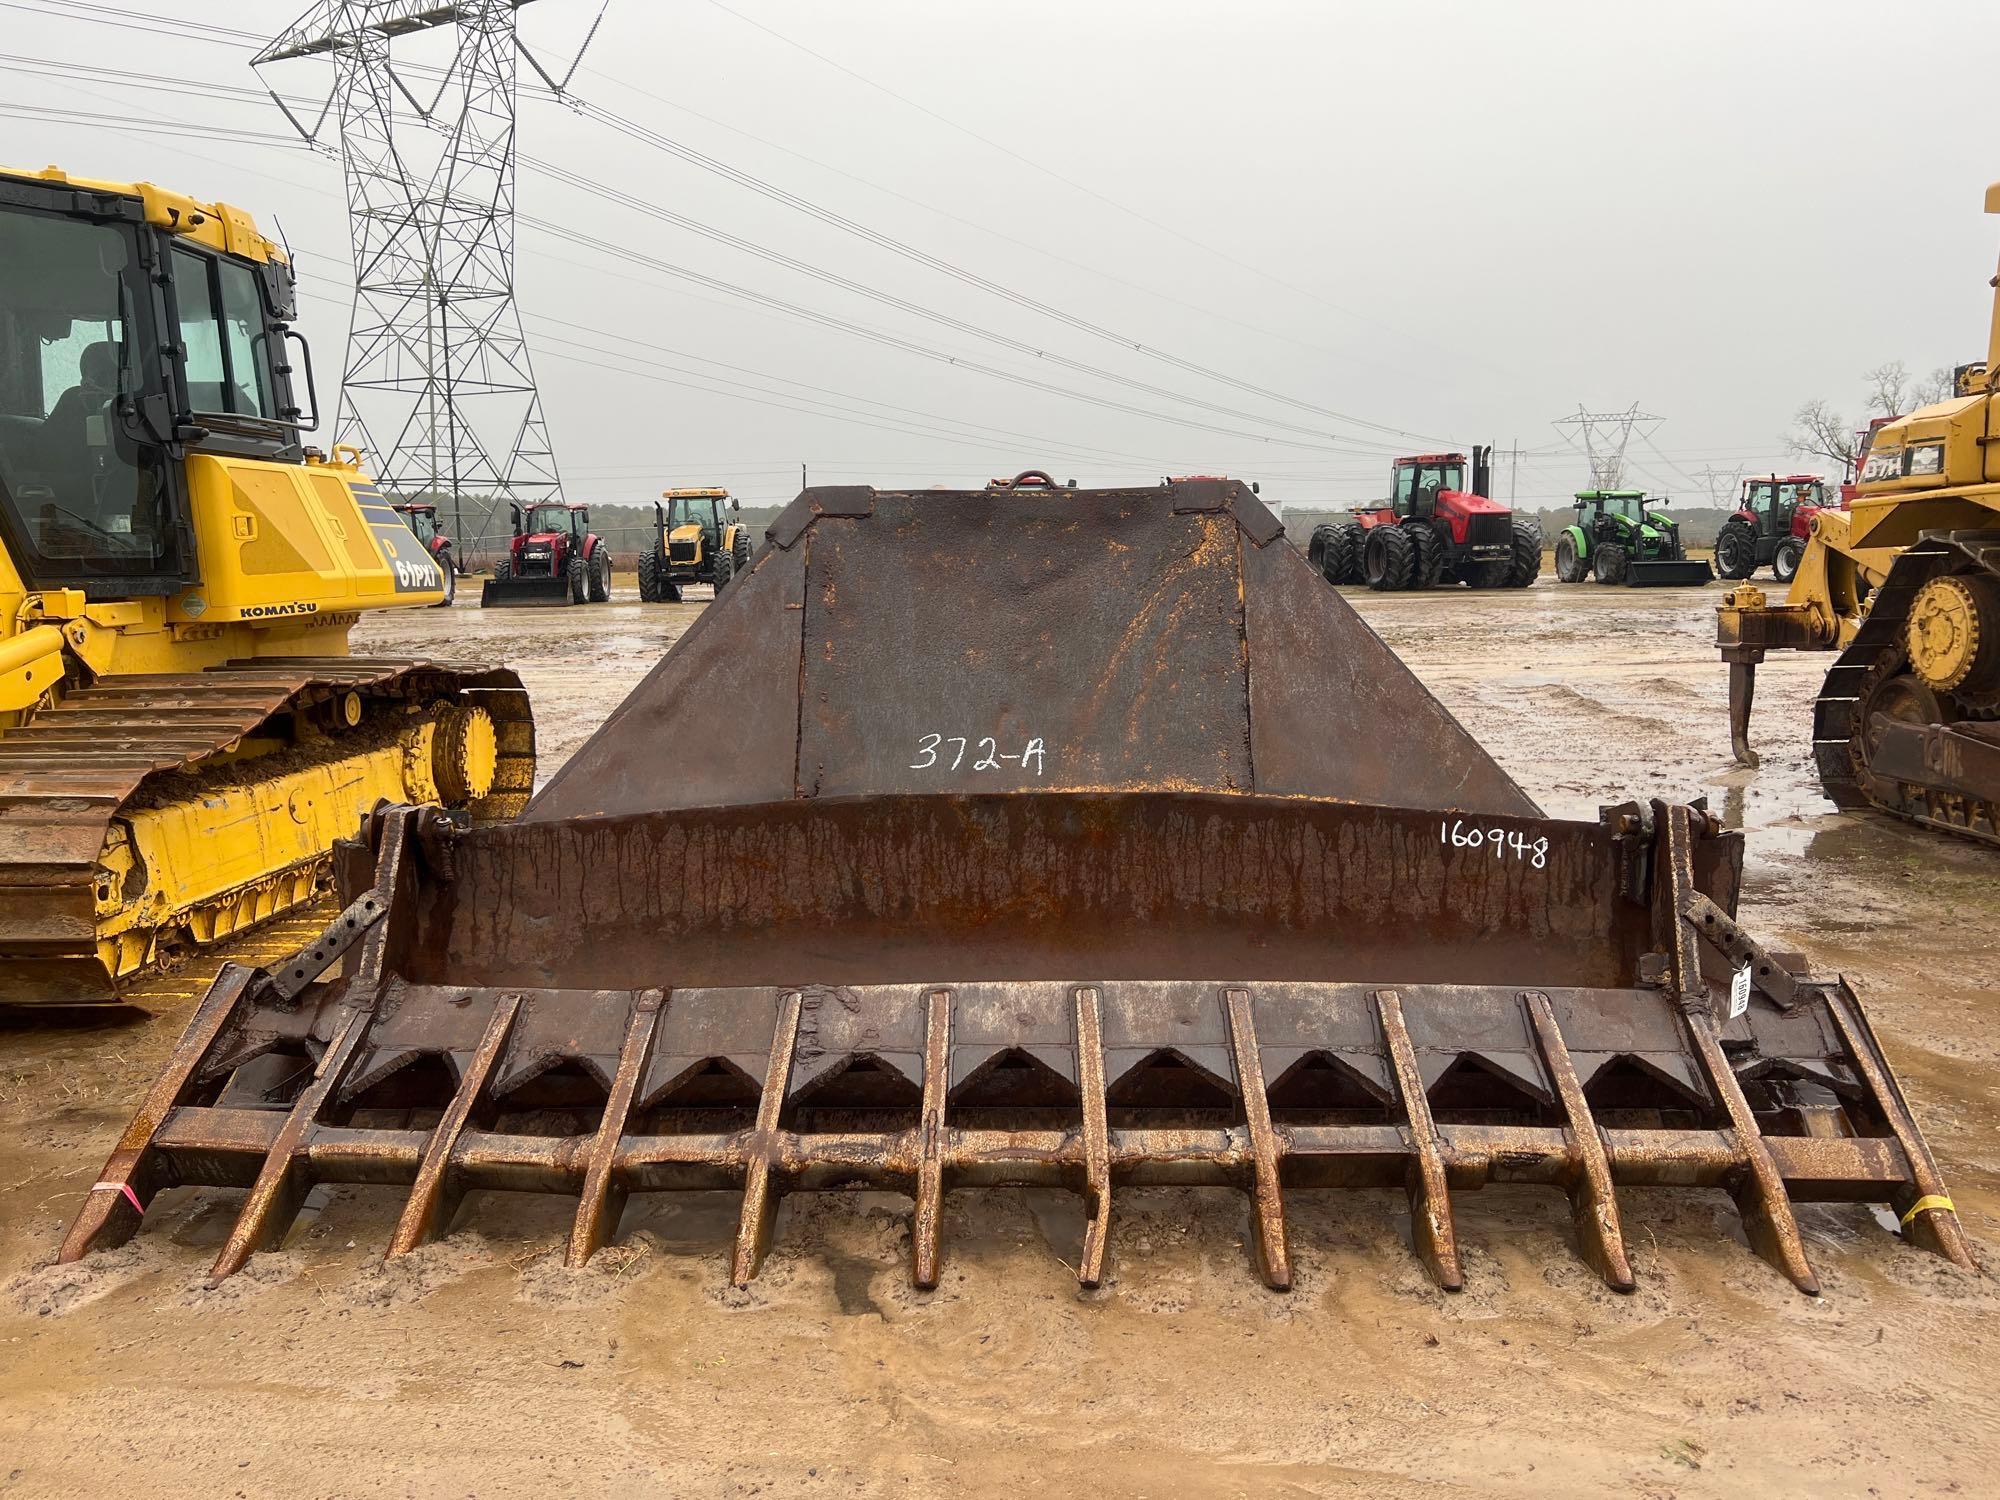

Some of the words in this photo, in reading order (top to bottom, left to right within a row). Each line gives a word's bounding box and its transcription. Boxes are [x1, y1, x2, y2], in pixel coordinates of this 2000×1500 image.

[240, 601, 317, 618] KOMATSU
[909, 733, 1046, 776] 372-A
[1441, 819, 1549, 869] 160948
